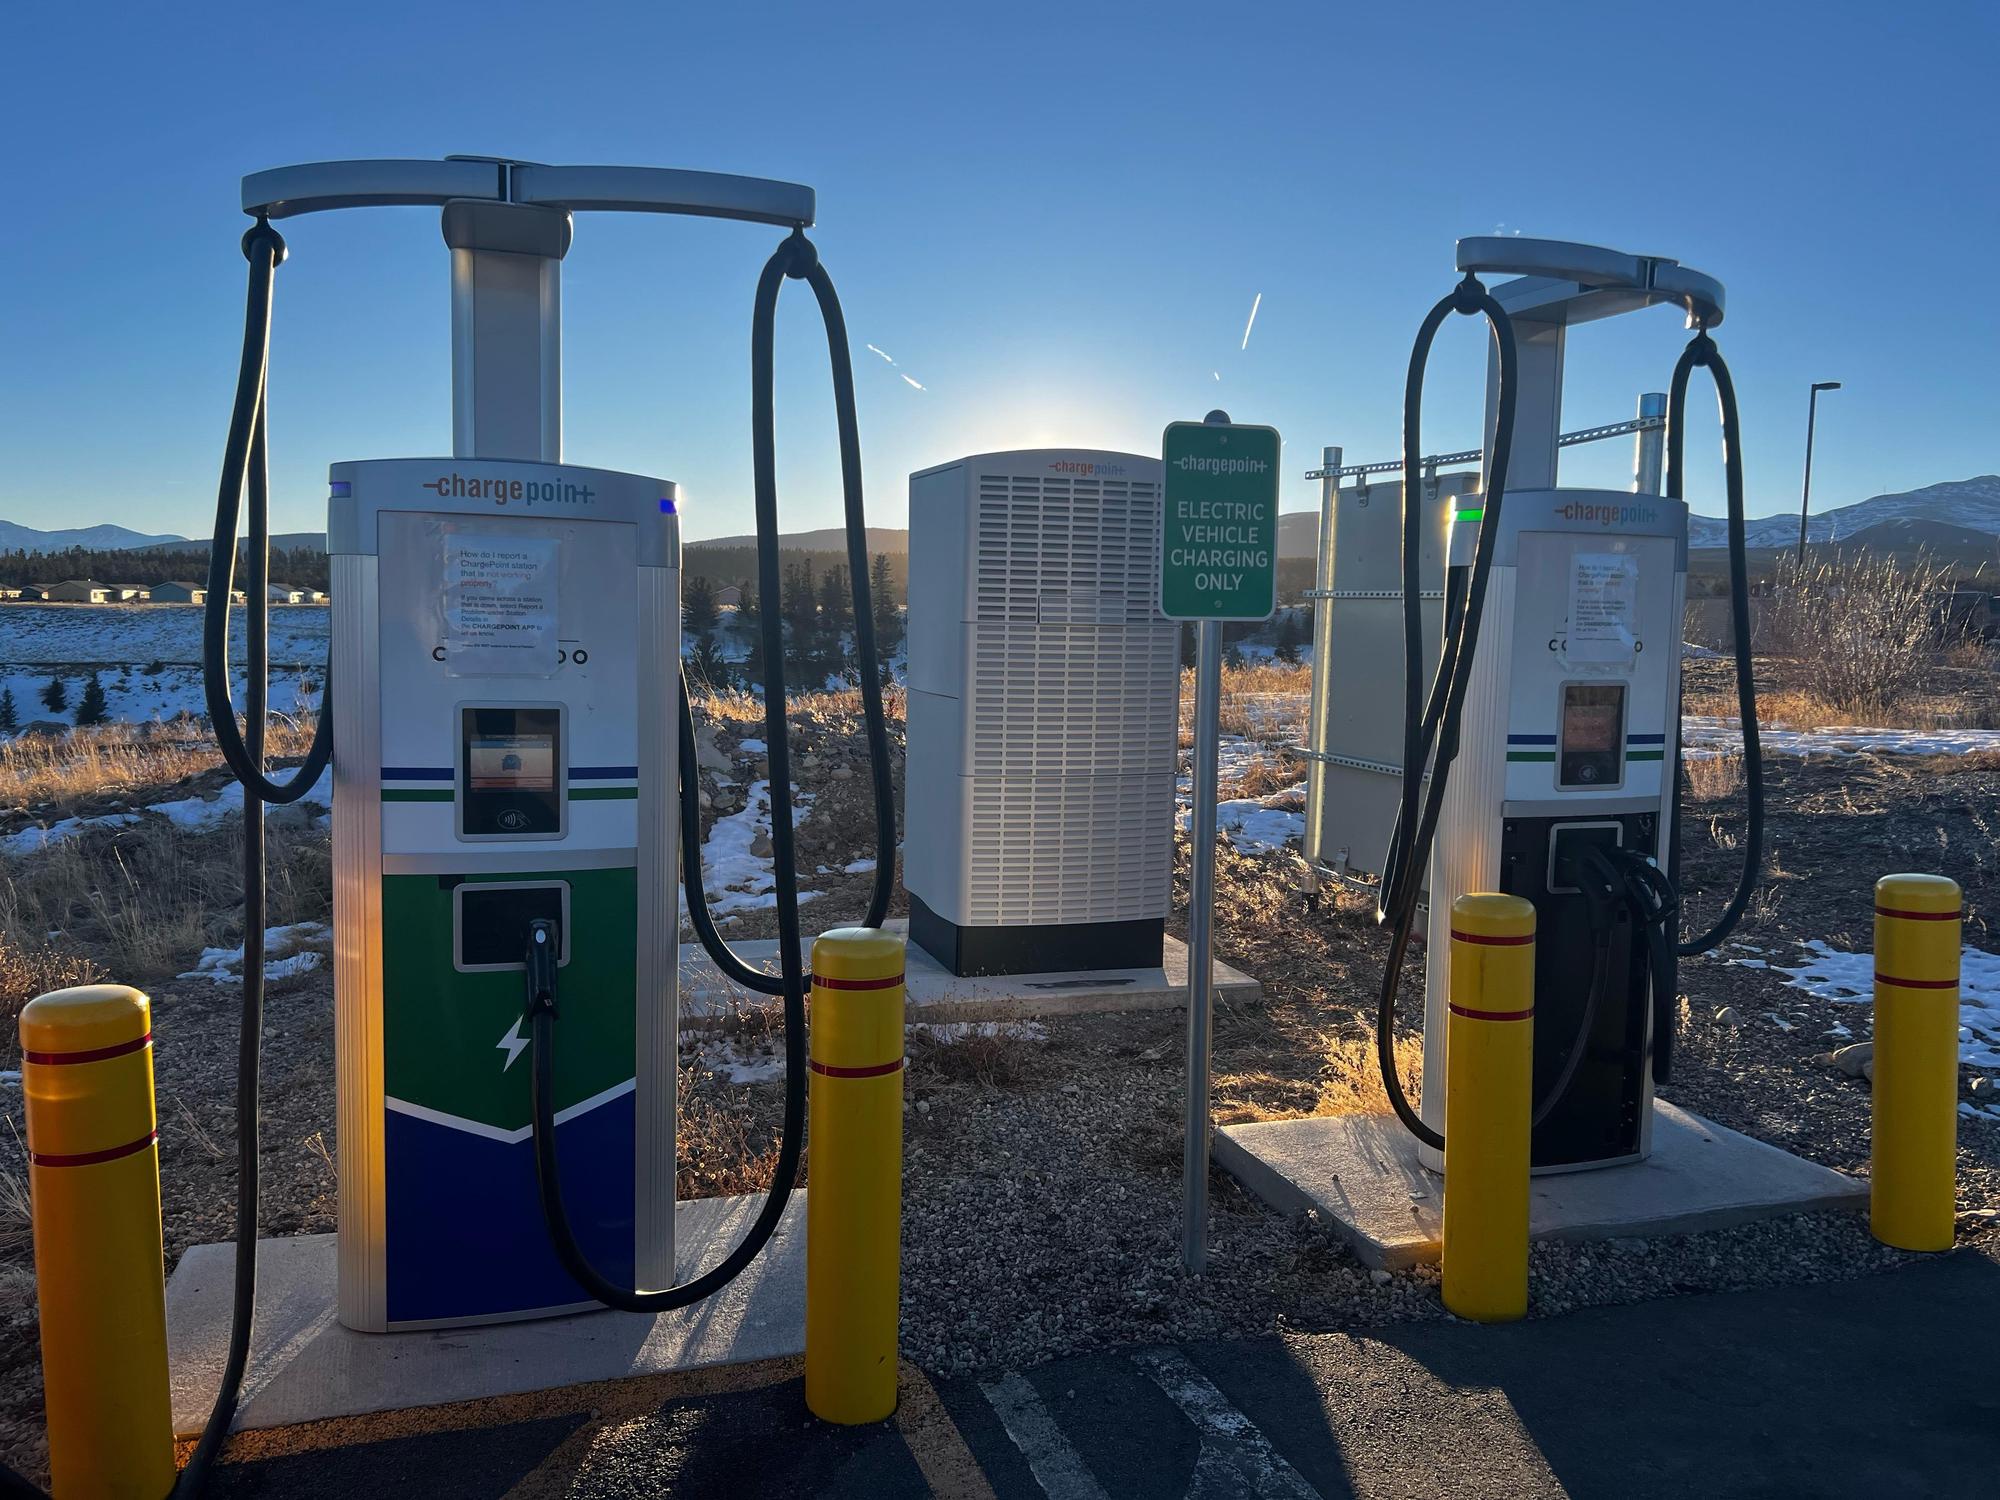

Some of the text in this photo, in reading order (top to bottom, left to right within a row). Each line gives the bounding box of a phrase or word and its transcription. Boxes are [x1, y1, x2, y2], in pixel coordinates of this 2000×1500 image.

[1177, 501, 1265, 521] ELECTRIC
[1182, 525, 1259, 544] VEHICLE
[460, 550, 478, 558] How
[498, 552, 521, 560] report
[1171, 549, 1268, 568] CHARGING
[460, 560, 538, 570] ChargePoint station
[1195, 574, 1244, 592] ONLY
[472, 623, 520, 631] CHARGEPOINT
